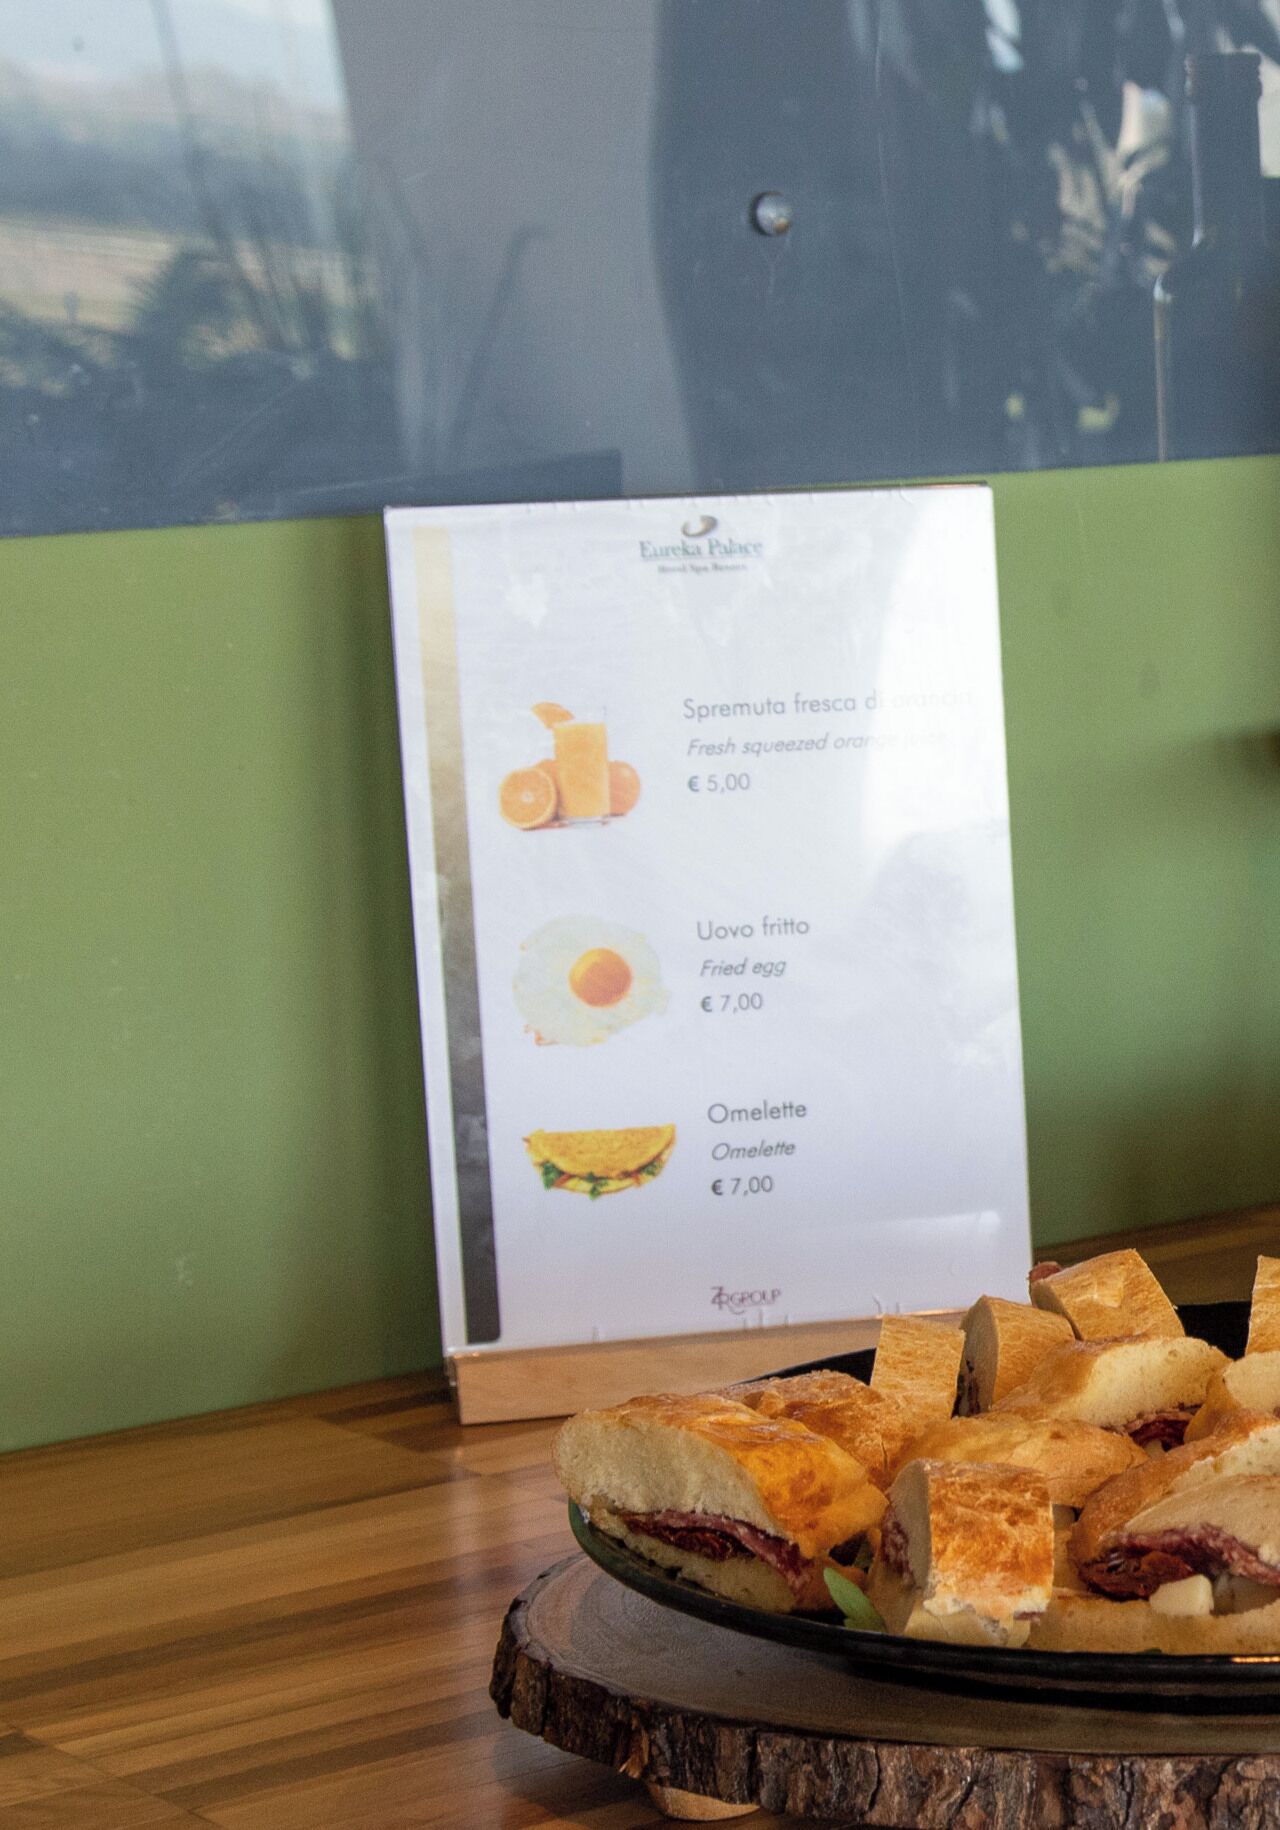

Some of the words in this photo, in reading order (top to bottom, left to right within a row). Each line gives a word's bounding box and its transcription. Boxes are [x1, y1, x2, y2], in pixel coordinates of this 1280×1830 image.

[639, 539, 702, 559] Eureka
[708, 537, 764, 557] Palace
[682, 697, 787, 723] Spremuta
[793, 691, 858, 715] fresca
[864, 687, 883, 712] di
[687, 738, 736, 756] Fresh
[741, 731, 828, 758] squeezed
[687, 776, 701, 793] €
[706, 773, 751, 794] 5,00
[696, 921, 754, 941] Uovo
[762, 915, 810, 937] fritto
[699, 955, 747, 978] Fried
[750, 959, 787, 980] egg
[701, 995, 713, 1013] €
[719, 992, 763, 1014] 7,00
[707, 1099, 808, 1125] Omelette
[711, 1139, 797, 1161] Omelette
[711, 1179, 724, 1196] €
[729, 1175, 774, 1198] 7,00
